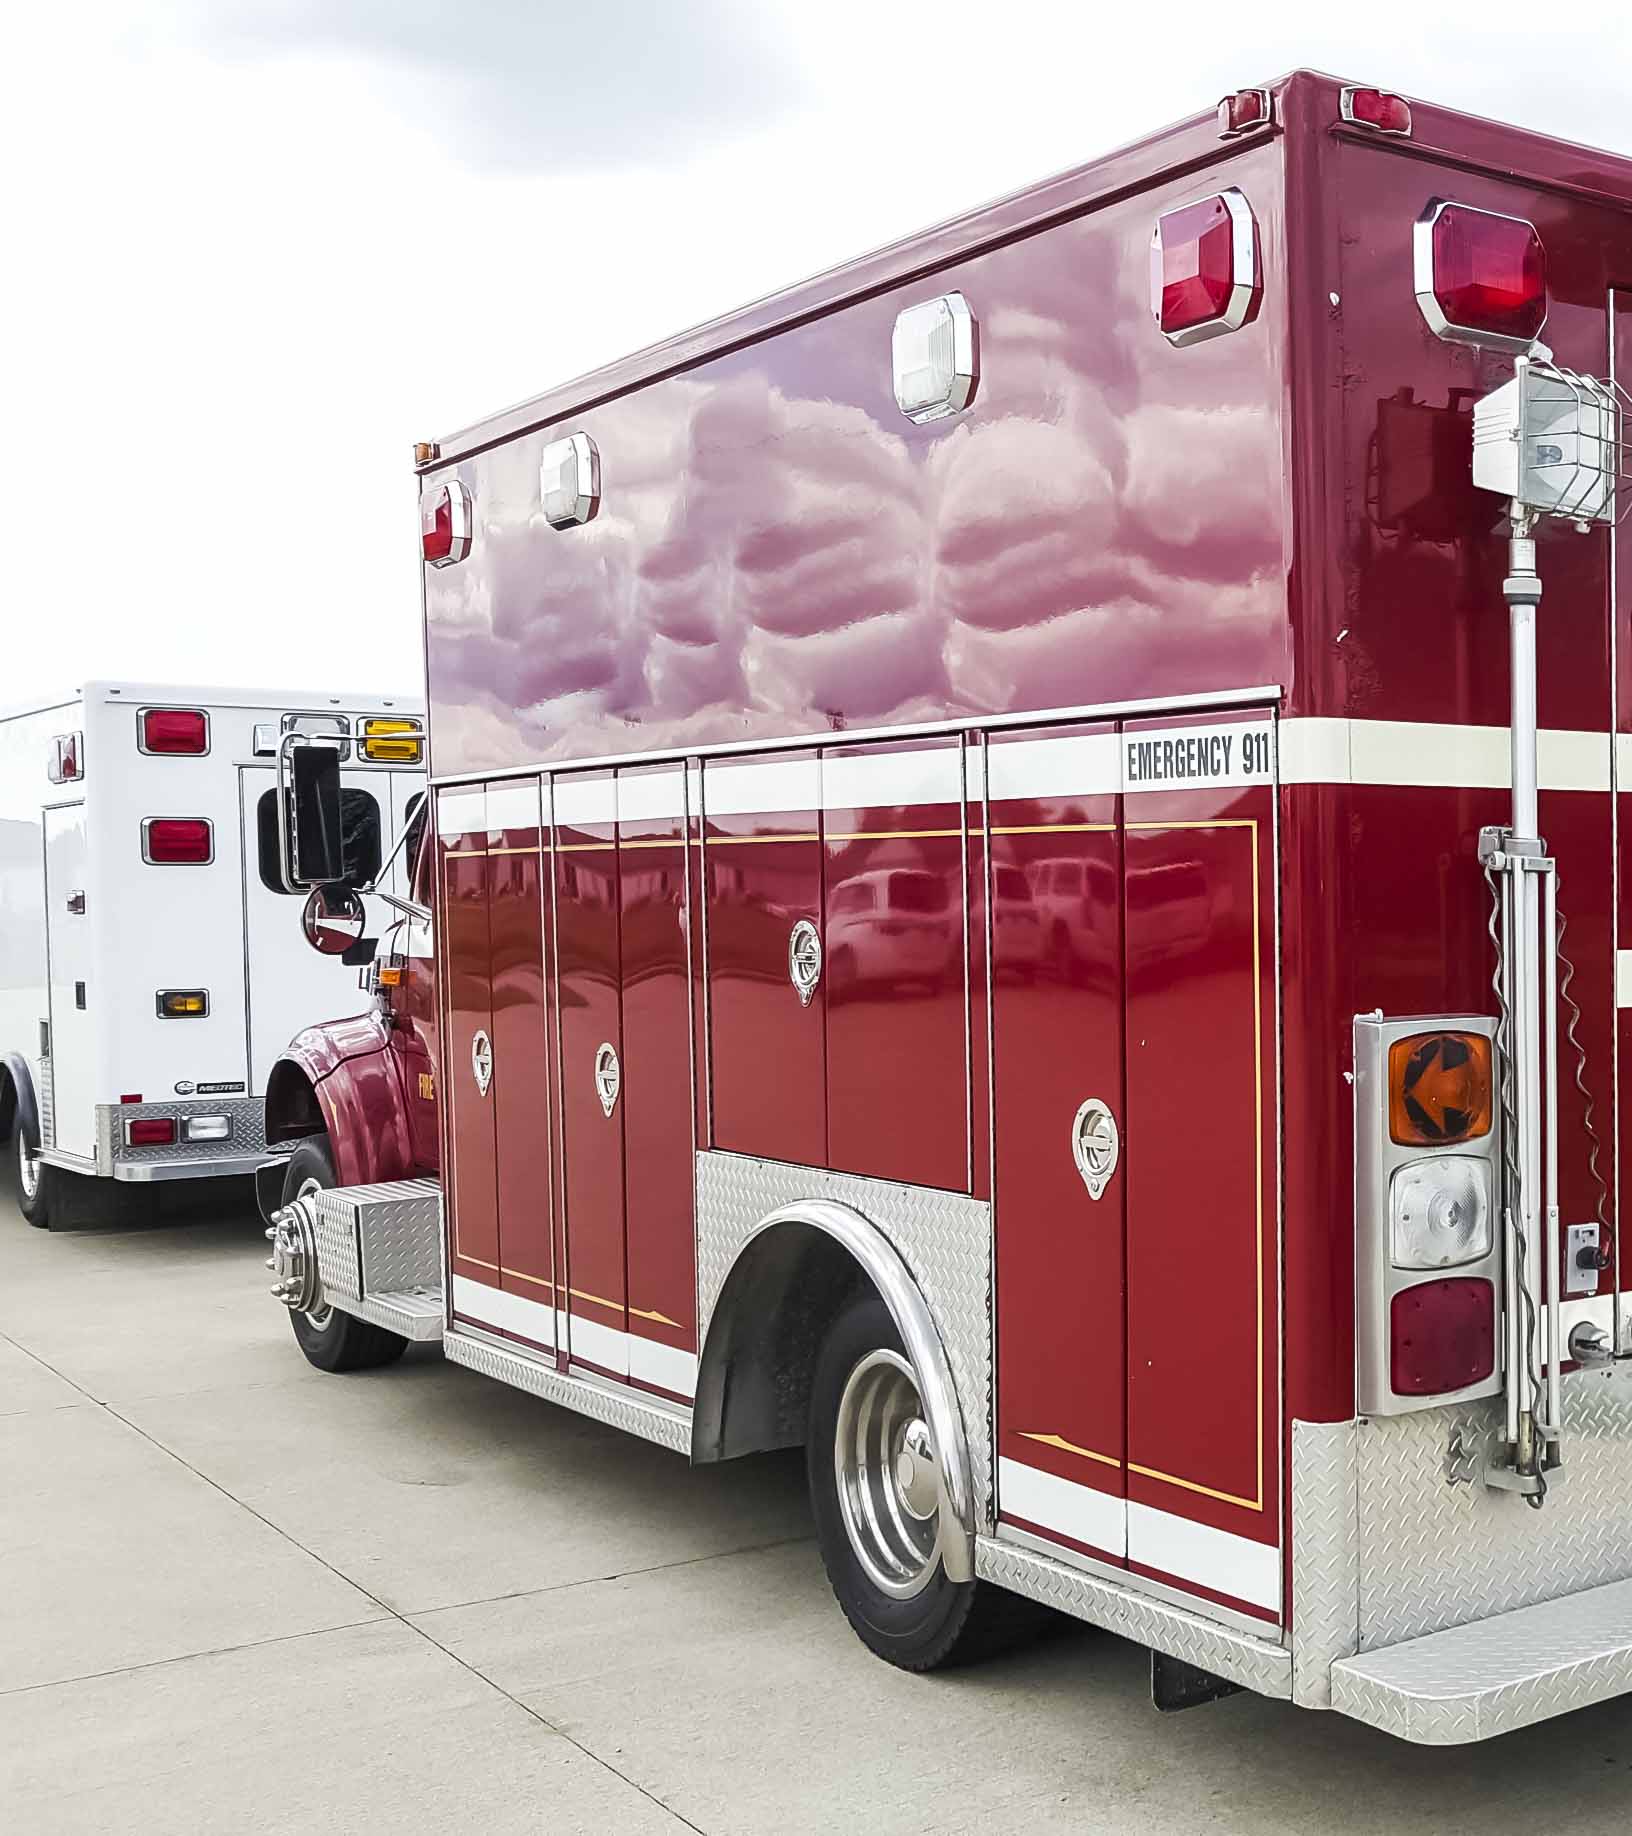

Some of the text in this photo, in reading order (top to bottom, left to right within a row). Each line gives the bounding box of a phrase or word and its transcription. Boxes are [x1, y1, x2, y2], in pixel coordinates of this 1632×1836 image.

[1128, 732, 1269, 780] EMERGENCY 911
[418, 1072, 434, 1100] FIRE
